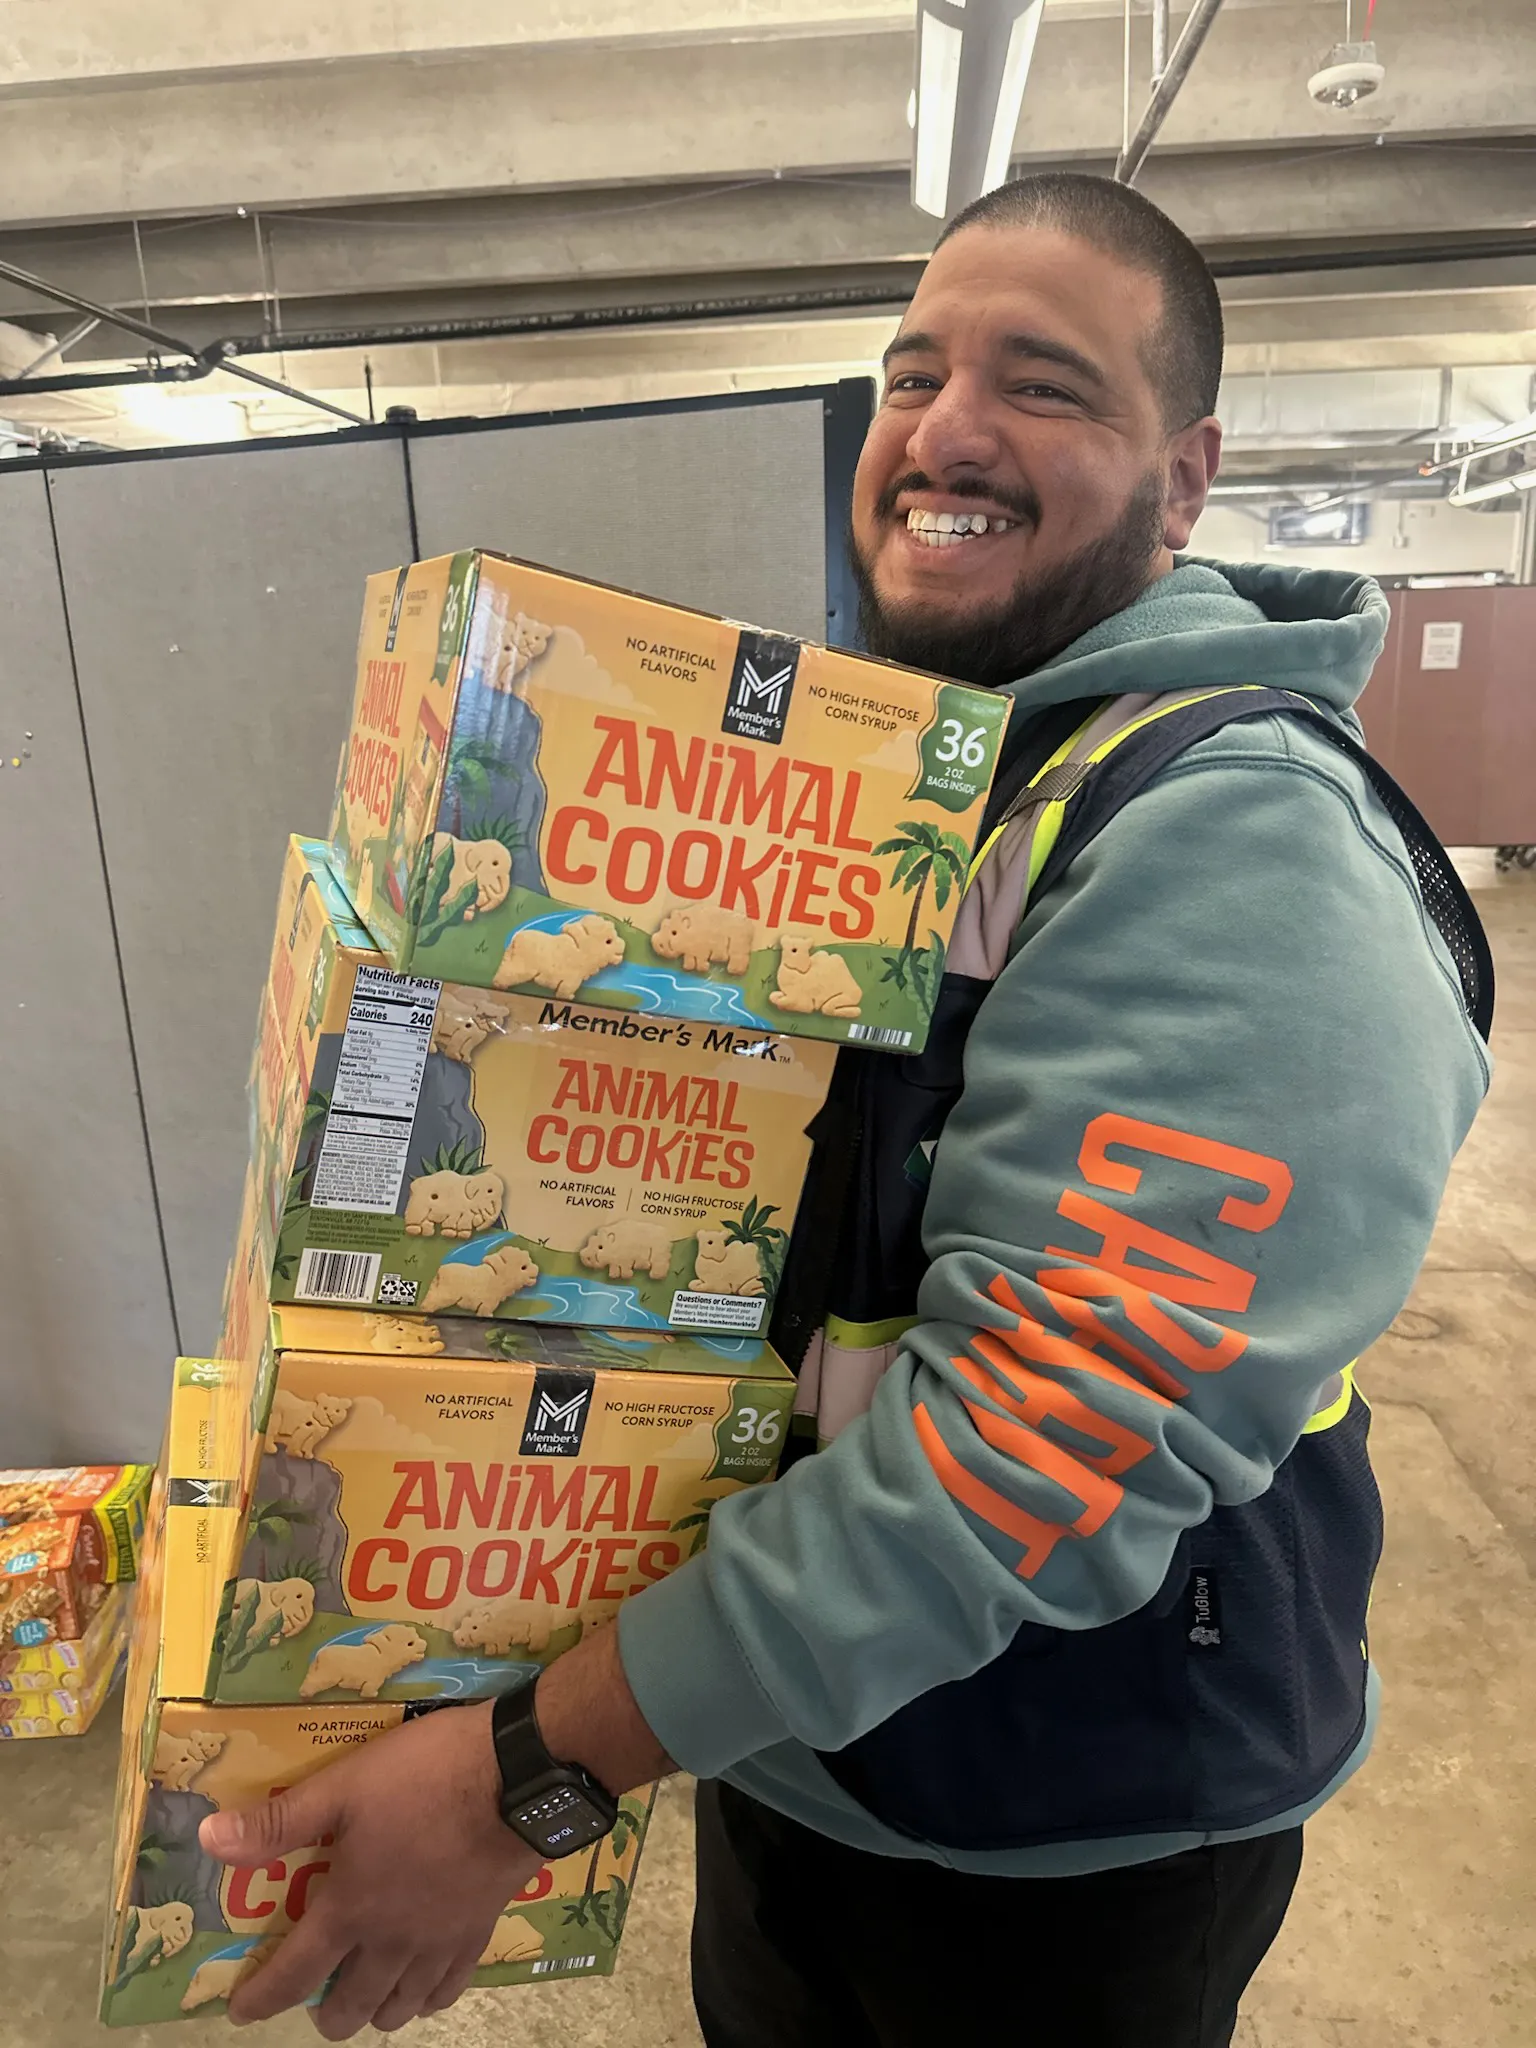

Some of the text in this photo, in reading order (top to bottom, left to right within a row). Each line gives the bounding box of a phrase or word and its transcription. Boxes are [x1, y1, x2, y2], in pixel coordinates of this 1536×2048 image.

[626, 637, 716, 671] NO ARTIFICIAL
[640, 658, 697, 682] FLAVORS
[808, 685, 920, 722] NO HIGH FRUCTOSE
[727, 706, 781, 729] Member's
[825, 706, 897, 732] CORN SYRUP
[738, 721, 766, 737] Mark
[935, 719, 987, 768] 36
[945, 766, 965, 780] 2 OZ
[926, 775, 977, 795] BAGS INSIDE
[359, 966, 440, 990] Nutrition Facts
[355, 986, 376, 995] Serving
[378, 988, 389, 996] size
[350, 1006, 433, 1026] Calories 240
[538, 1002, 692, 1047] Member's
[702, 1029, 779, 1062] Mark
[540, 1179, 616, 1196] NO ARTIFICIAL
[566, 1196, 614, 1209] FLAVORS
[644, 1191, 745, 1211] NO HIGH FRUCTOSE
[640, 1204, 707, 1219] CORN SYRUP
[677, 1294, 711, 1304] Questions
[721, 1298, 762, 1308] Comments?
[425, 1394, 513, 1407] NO ARTIFICIAL
[604, 1401, 715, 1416] NO HIGH FRUCTOSE
[438, 1408, 494, 1420] FLAVORS
[621, 1416, 693, 1428] CORN SYRUP
[731, 1407, 782, 1445] 36
[525, 1432, 578, 1443] Member's
[535, 1443, 564, 1453] Mark
[741, 1447, 760, 1456] 2 OZ
[723, 1457, 772, 1467] BAGS INSIDE
[197, 1519, 207, 1551] ARTIFICIAL
[1194, 1576, 1210, 1623] TuGlow
[298, 1720, 385, 1732] NO ARTIFICIAL
[312, 1734, 367, 1744] FLAVORS
[547, 1827, 573, 1843] 10:45
